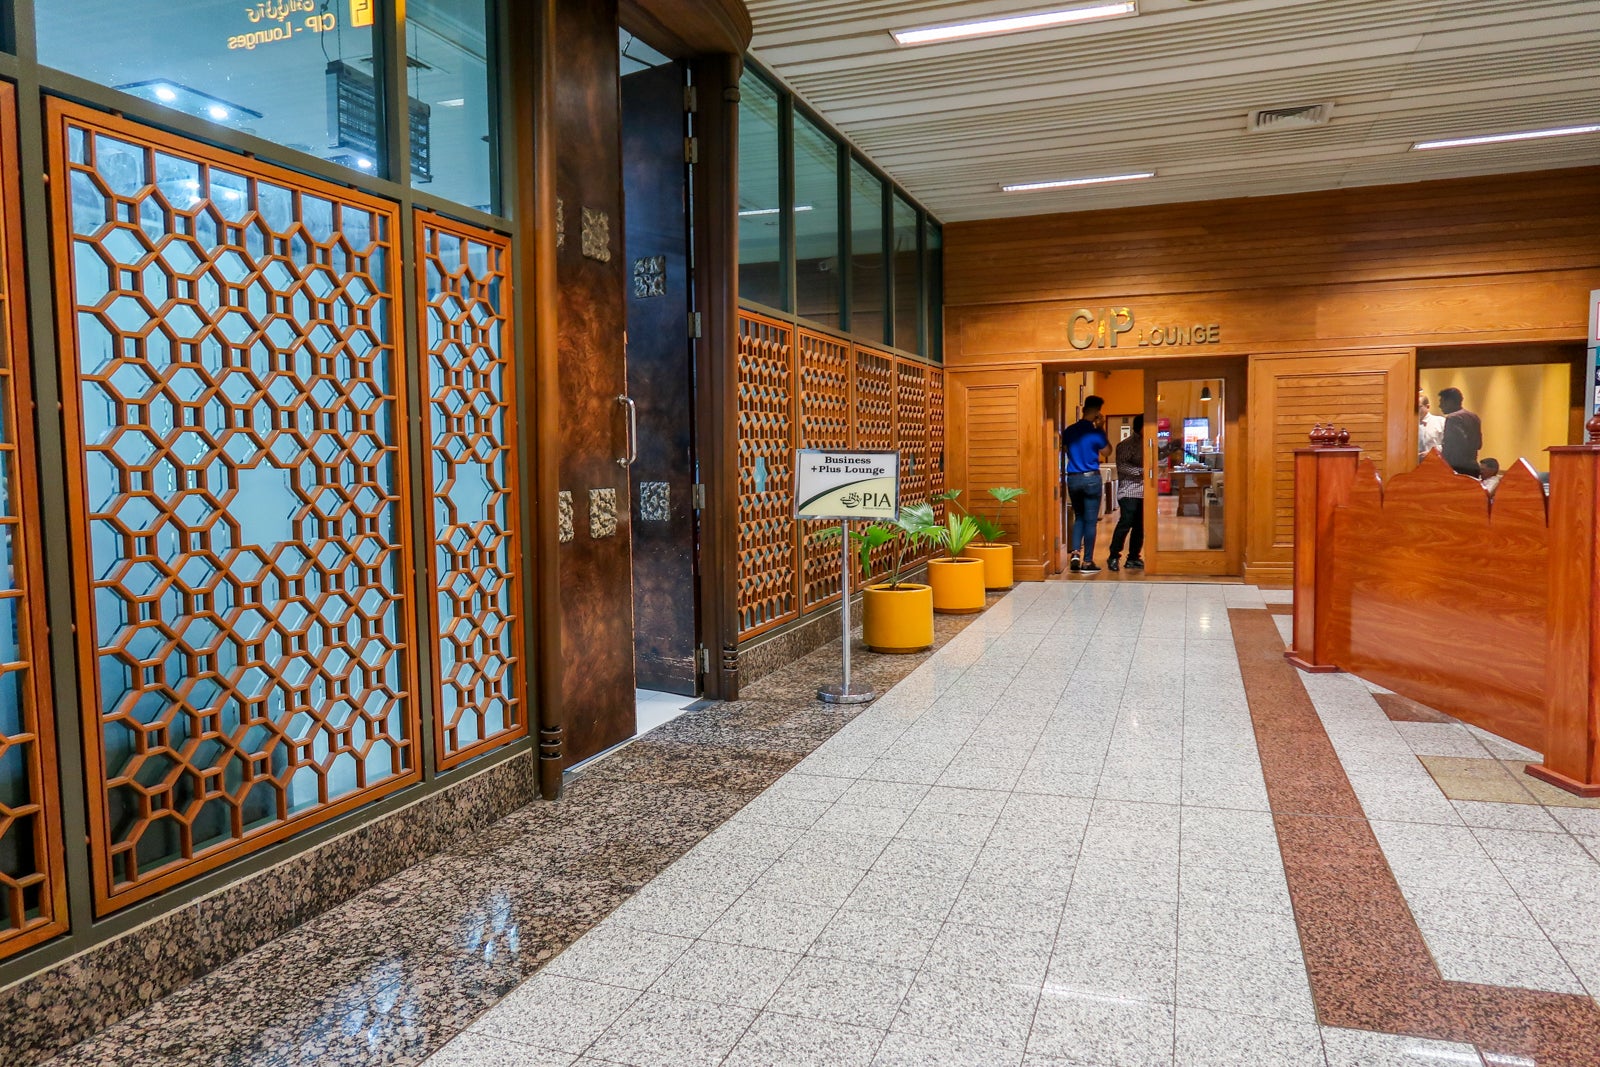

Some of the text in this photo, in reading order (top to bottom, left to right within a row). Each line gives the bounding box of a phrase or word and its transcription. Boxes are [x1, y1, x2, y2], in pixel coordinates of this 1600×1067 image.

[1067, 307, 1220, 350] CIP LOUNGE
[825, 456, 872, 464] Business
[811, 465, 885, 476] +Plus Lounge
[862, 492, 892, 507] PIA
